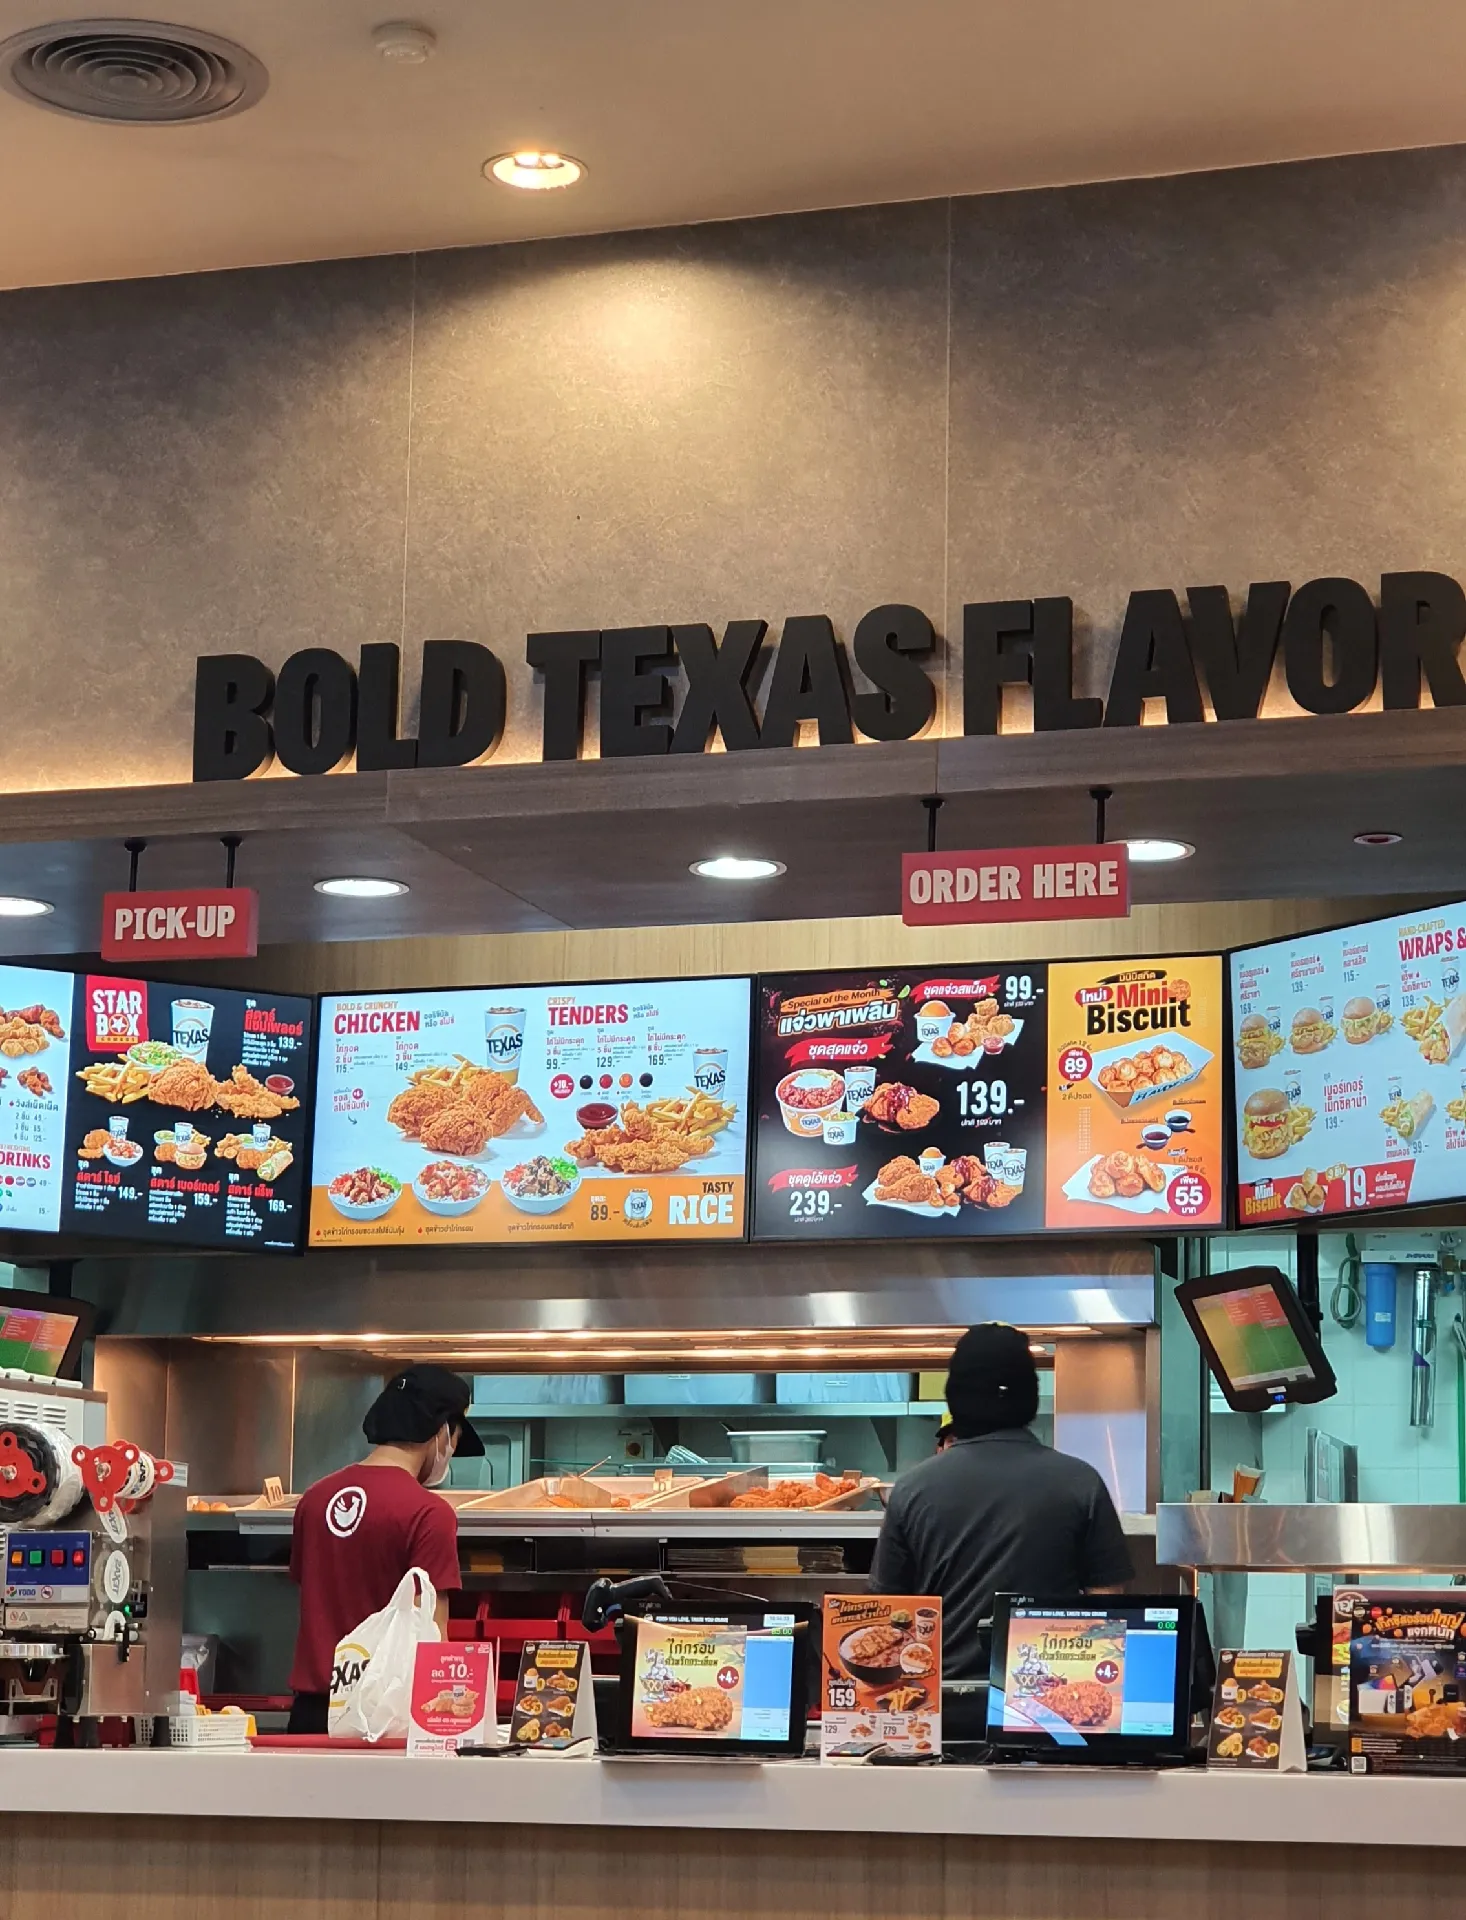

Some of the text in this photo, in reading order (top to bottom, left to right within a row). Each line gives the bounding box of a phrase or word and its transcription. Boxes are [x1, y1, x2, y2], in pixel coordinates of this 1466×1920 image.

[193, 570, 1466, 782] BOLD TEXAS FLAVOR
[909, 860, 1119, 904] ORDER HERE
[114, 905, 236, 941] PICK-UP
[1398, 929, 1454, 961] WRAPS
[1005, 975, 1044, 1000] 99.-
[1080, 987, 1108, 1003] ใหม่!
[1117, 980, 1168, 1008] Mini
[92, 989, 143, 1014] STAR
[336, 1003, 356, 1011] BOLD
[364, 1001, 399, 1010] CRUNCHY
[547, 997, 576, 1006] CRISPY
[787, 989, 881, 1009] Special of the Month
[96, 1013, 140, 1036] BOX
[334, 1011, 420, 1034] CHICKEN
[548, 1004, 628, 1026] TENDERS
[779, 1000, 898, 1034] แจ่วพาเพลิน
[1087, 997, 1191, 1036] Biscuit
[173, 1028, 209, 1048] TEXAS
[486, 1033, 523, 1057] TEXAS
[808, 1040, 869, 1060] ชุดสุดแจ่ว
[1064, 1057, 1088, 1073] 89
[694, 1070, 726, 1091] TEXAS
[1323, 1075, 1364, 1096] เบอร์เกอร์
[956, 1080, 1026, 1115] 139.-
[118, 1186, 143, 1200] 149.-
[702, 1181, 734, 1194] TASTY
[1174, 1185, 1204, 1206] 55
[1254, 1184, 1274, 1200] Mini
[193, 1193, 218, 1206] 159.-
[268, 1199, 293, 1212] 169.-
[668, 1194, 734, 1225] RICE
[789, 1189, 843, 1216] 239.-
[1245, 1193, 1282, 1216] Biscuit
[1040, 1633, 1093, 1650] ไก่กรอบ
[1407, 1625, 1455, 1640] แจกหนัก
[665, 1638, 716, 1655] ไก่กรอบ
[883, 1726, 897, 1735] 279
